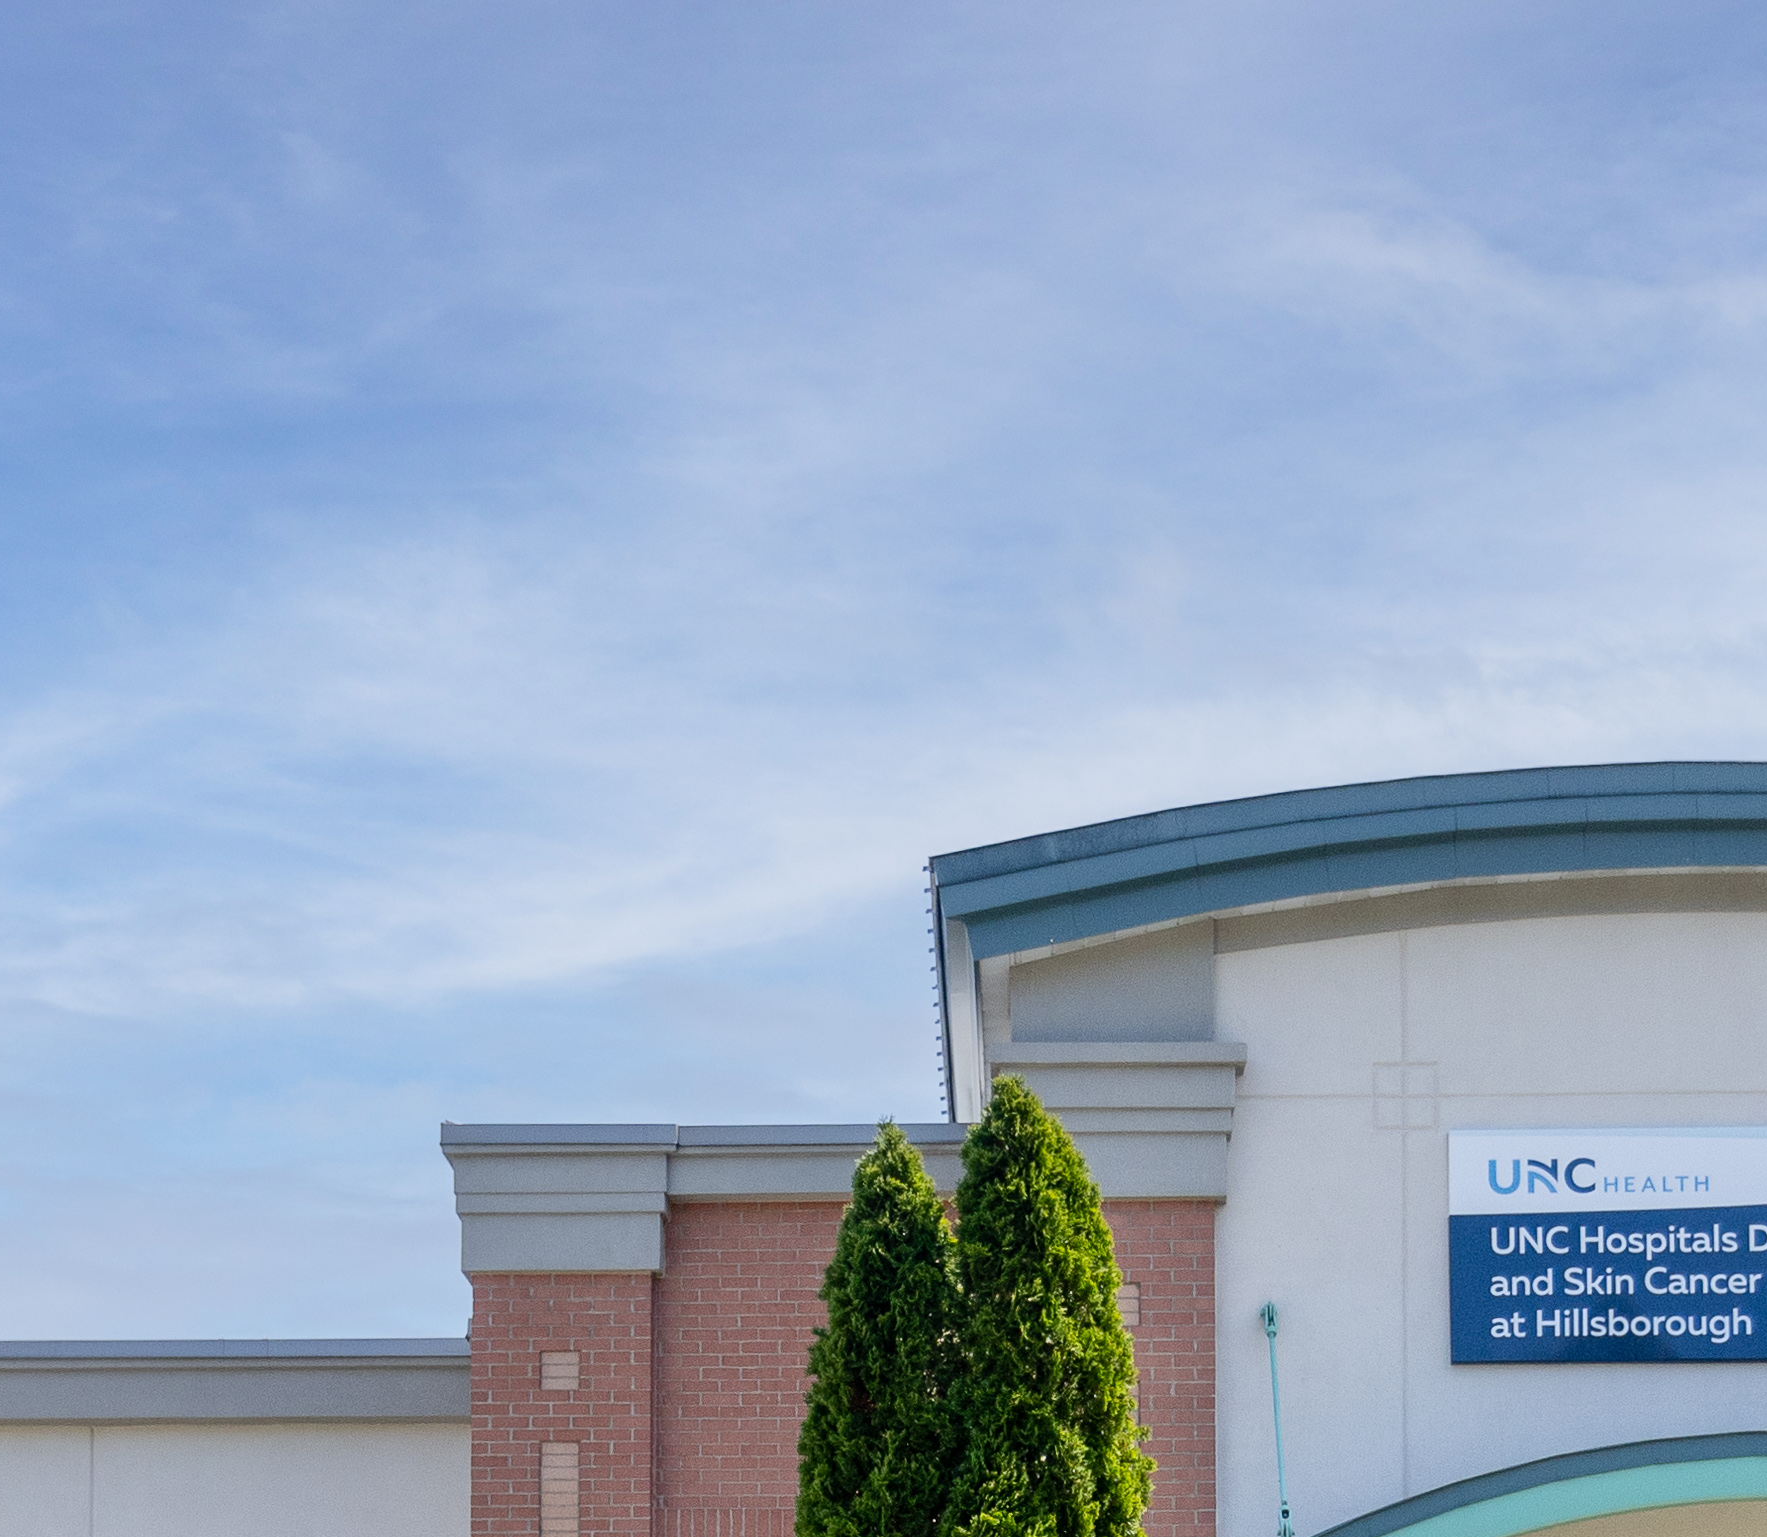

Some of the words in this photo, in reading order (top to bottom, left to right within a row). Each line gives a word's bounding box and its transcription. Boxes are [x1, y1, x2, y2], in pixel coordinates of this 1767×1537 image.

[1488, 1157, 1596, 1195] UNC
[1603, 1175, 1710, 1193] HEALTH
[1490, 1225, 1570, 1255] UNC
[1579, 1223, 1739, 1261] Hospitals
[1489, 1267, 1554, 1297] and
[1563, 1266, 1635, 1296] Skin
[1644, 1265, 1762, 1295] Cancer
[1490, 1311, 1527, 1338] at
[1536, 1307, 1753, 1345] Hillsborough
